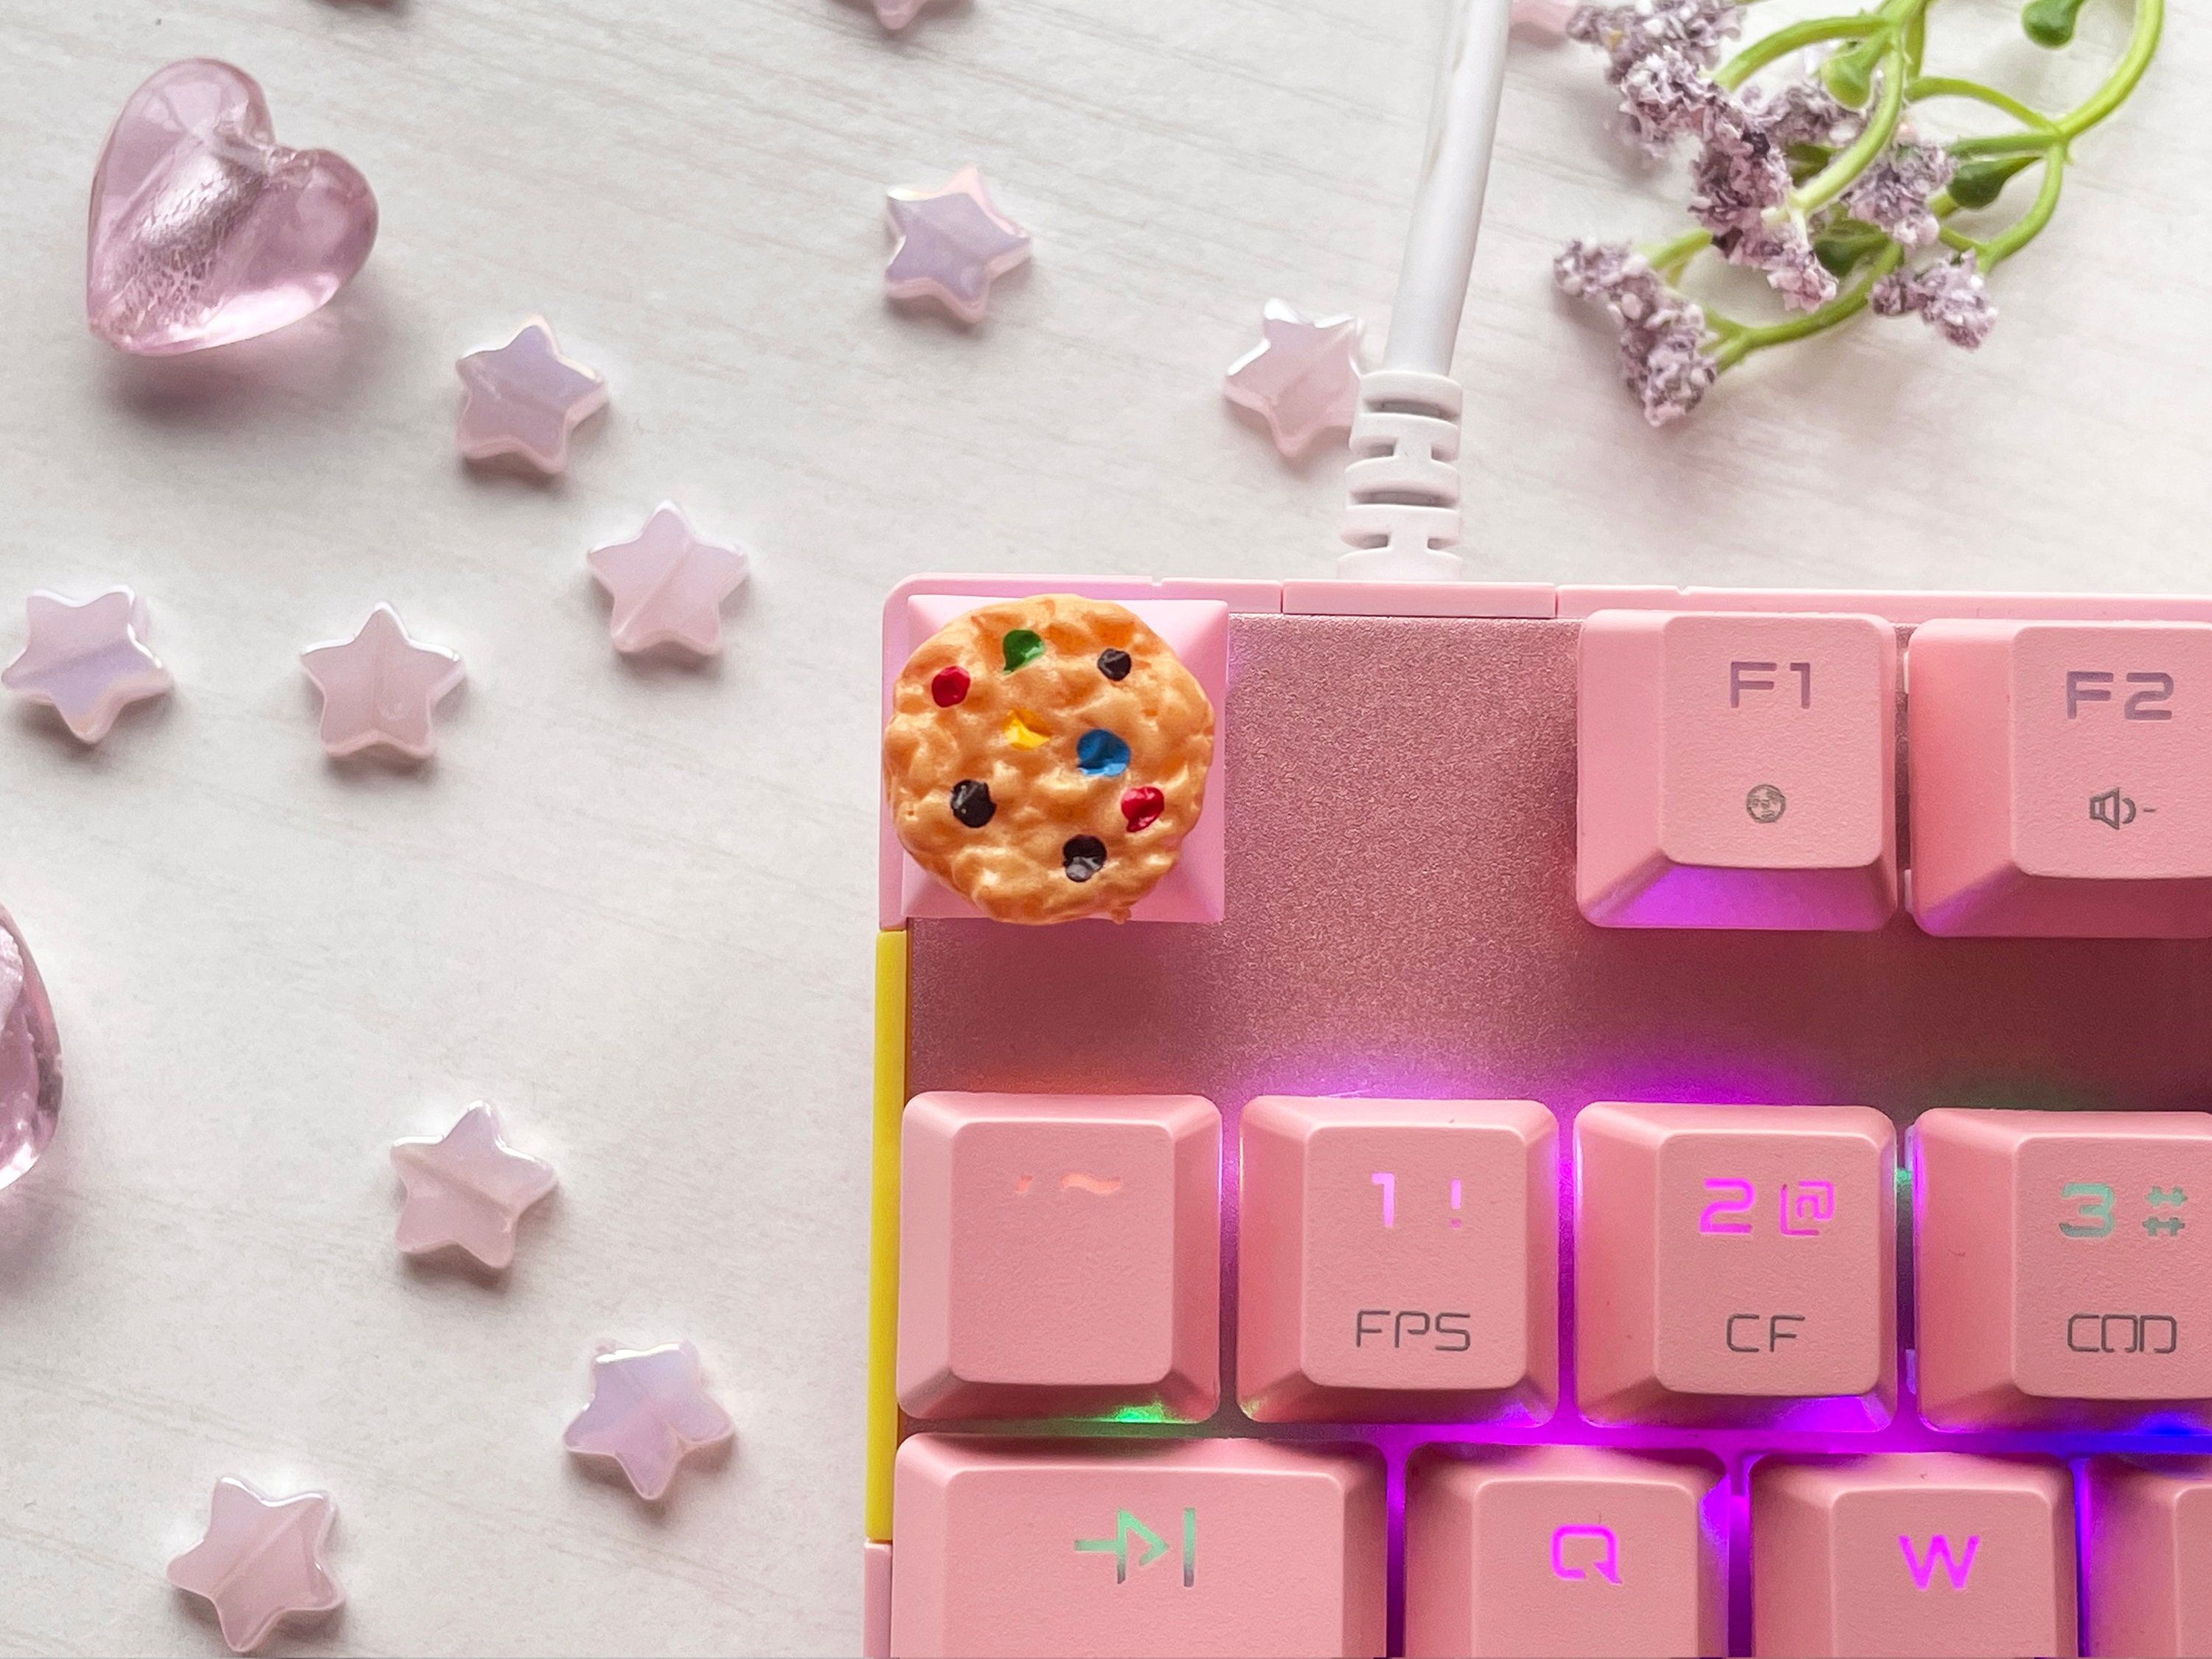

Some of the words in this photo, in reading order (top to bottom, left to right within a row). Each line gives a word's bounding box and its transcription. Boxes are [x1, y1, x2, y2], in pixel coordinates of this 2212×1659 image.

[1729, 661, 1812, 710] F1
[2065, 670, 2175, 721] F2
[1371, 1172, 1396, 1228] 1
[1699, 1178, 1757, 1234] 2
[2058, 1182, 2115, 1239] 3
[1354, 1309, 1472, 1352] FPS
[1725, 1312, 1806, 1353] CF
[1550, 1523, 1622, 1585] Q
[1897, 1534, 1980, 1593] W
